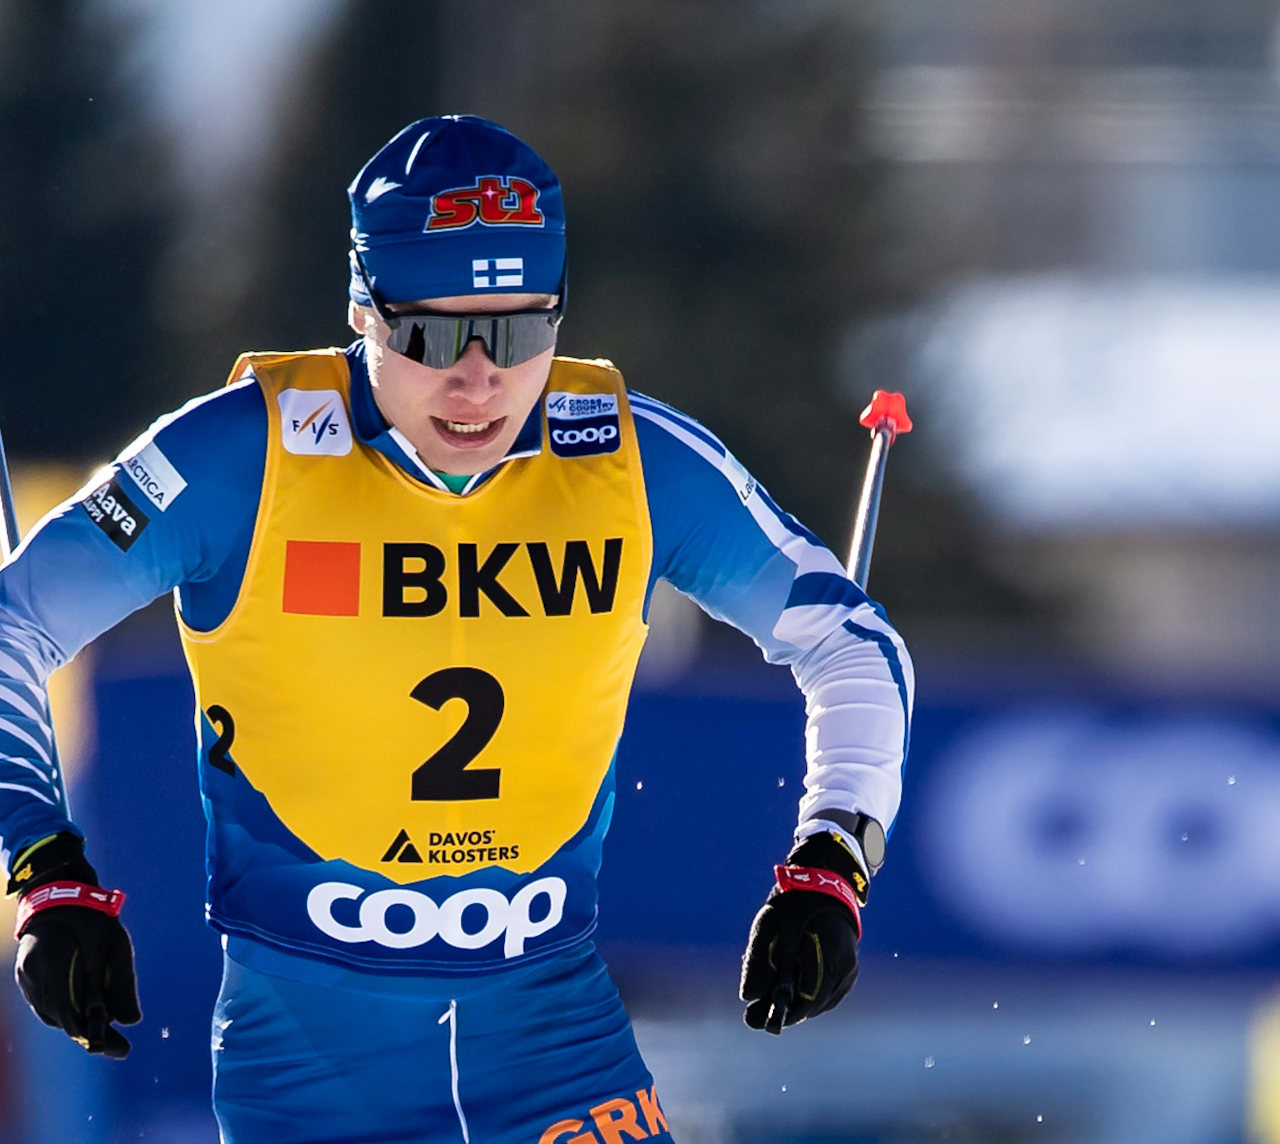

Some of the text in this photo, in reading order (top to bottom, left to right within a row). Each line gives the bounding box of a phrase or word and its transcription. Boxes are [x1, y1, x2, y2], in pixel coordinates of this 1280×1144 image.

[423, 175, 545, 233] st1
[552, 425, 617, 444] coop
[382, 538, 623, 618] BKW
[206, 705, 236, 778] 2
[409, 667, 505, 801] 2
[429, 845, 519, 863] KLOSTERS
[307, 877, 567, 959] coop
